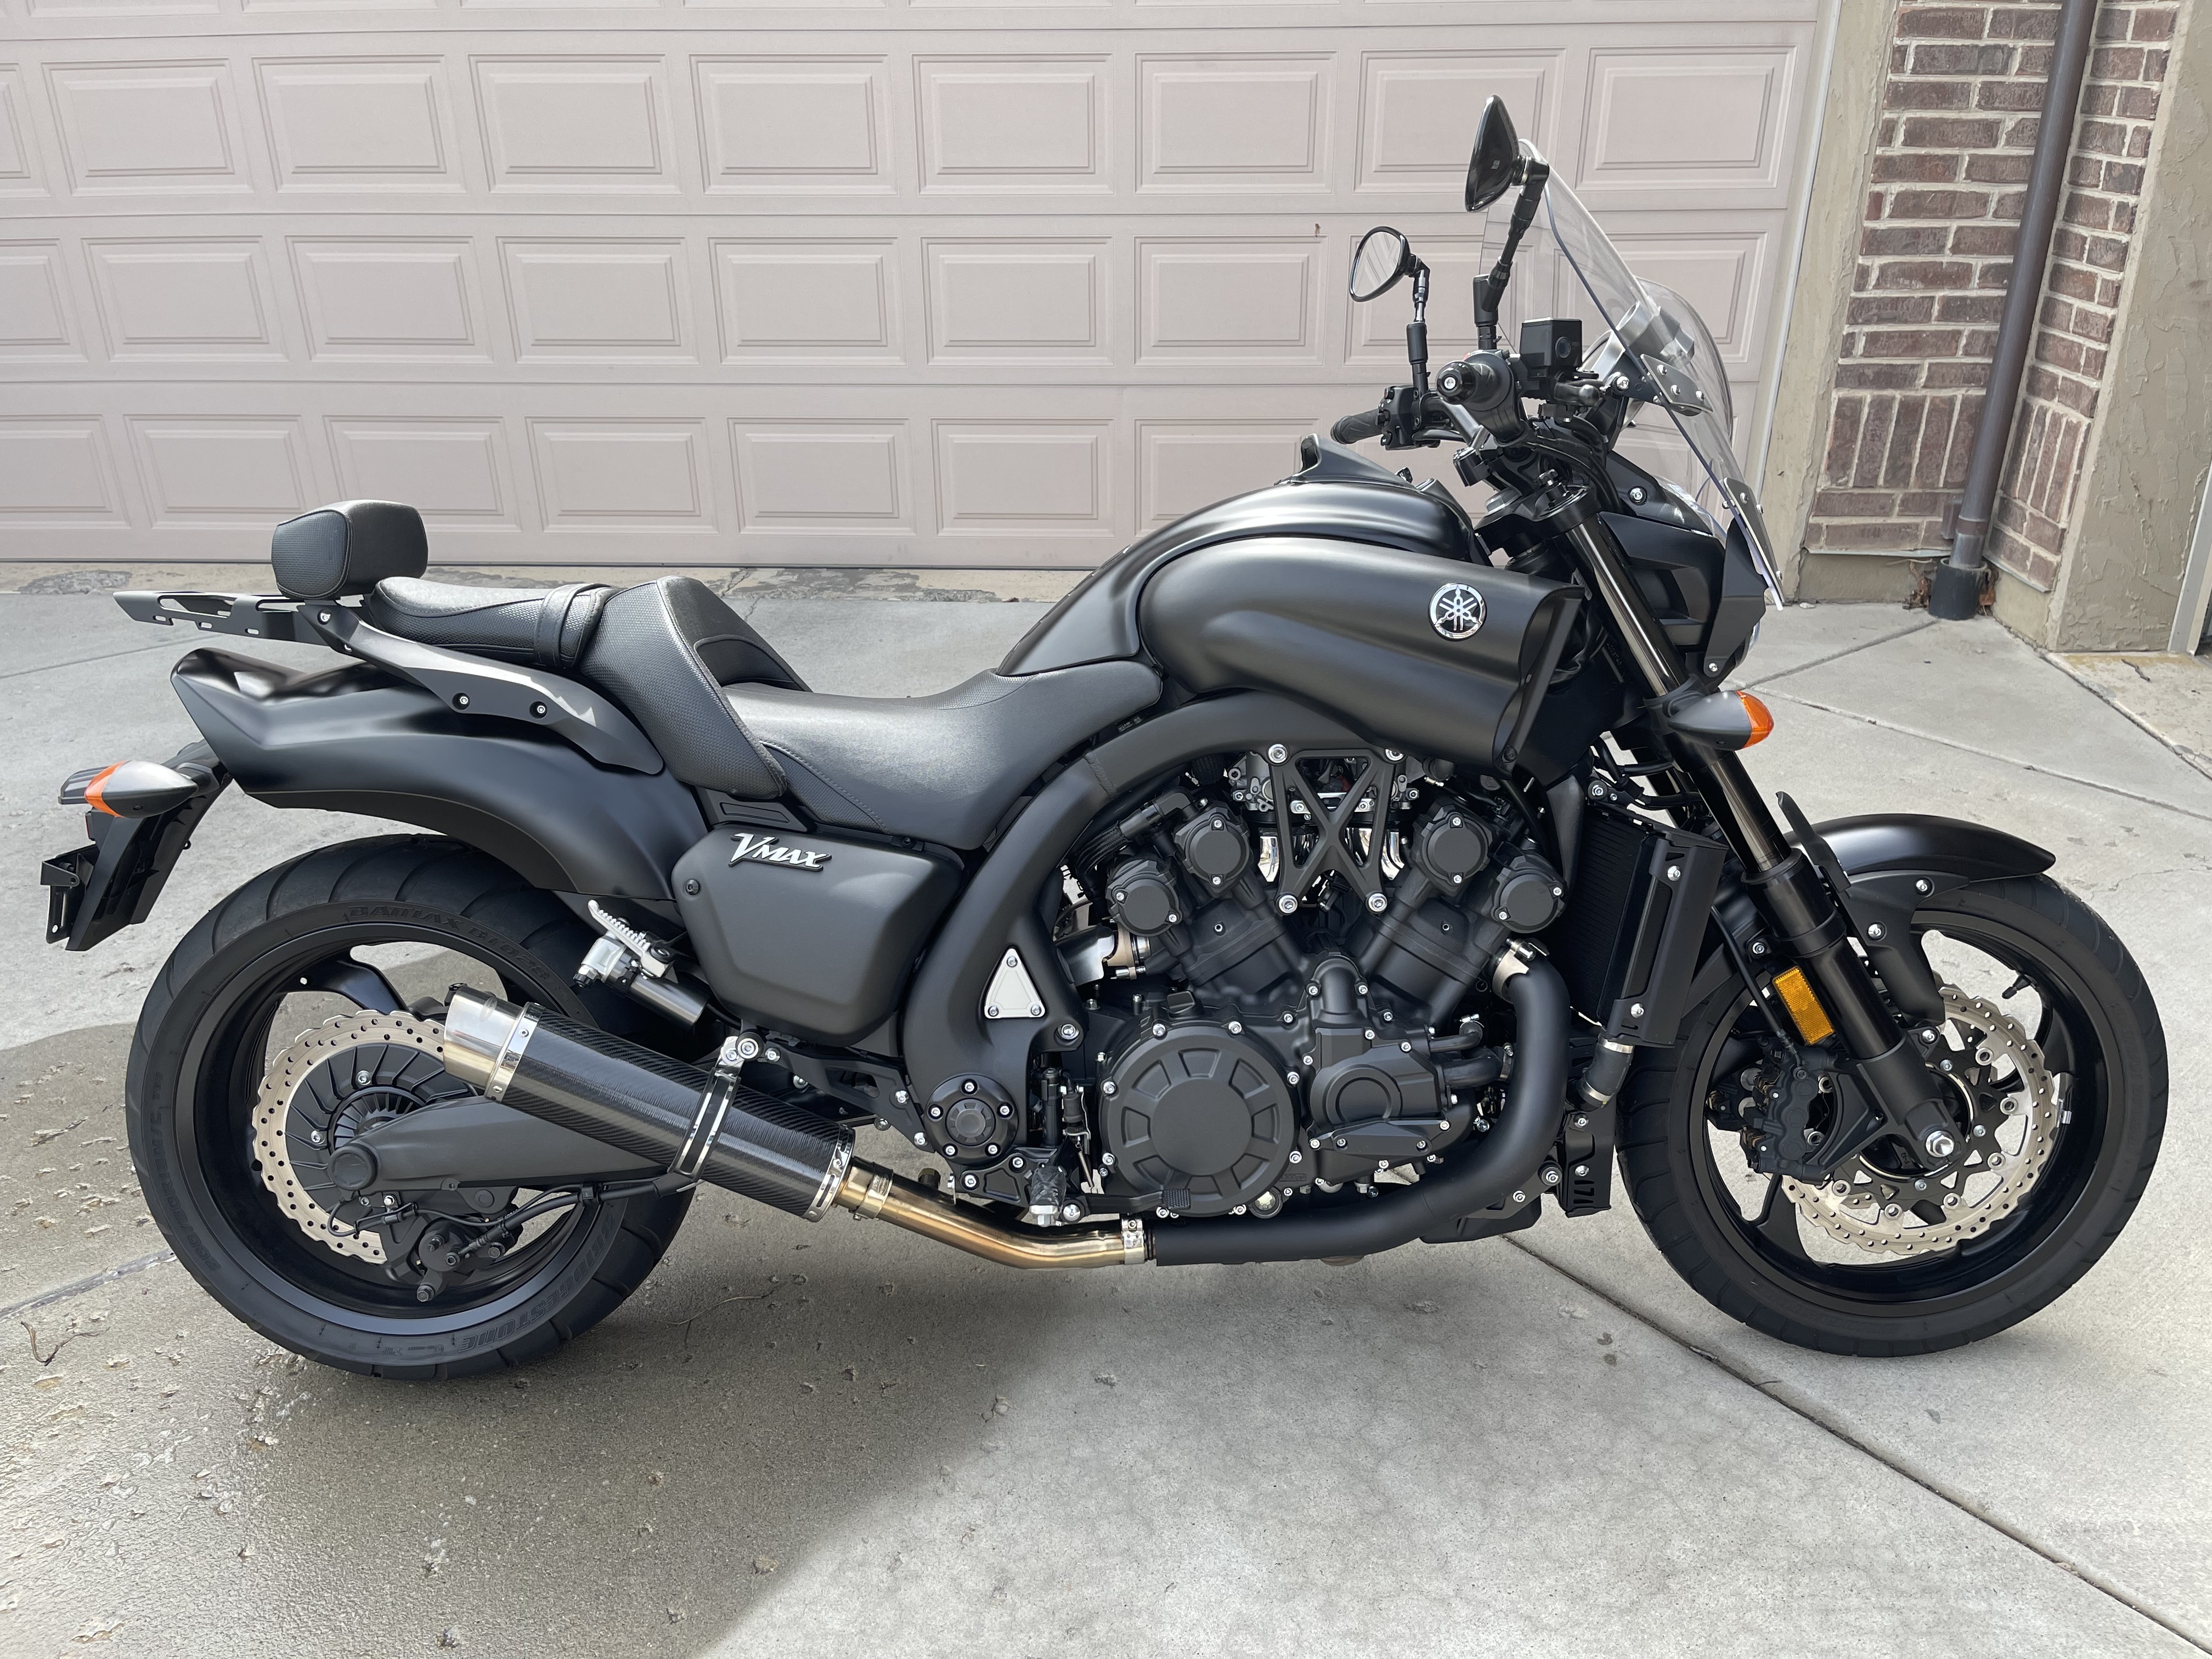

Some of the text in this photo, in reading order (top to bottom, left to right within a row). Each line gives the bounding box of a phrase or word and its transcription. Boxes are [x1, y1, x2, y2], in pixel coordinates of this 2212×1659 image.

[730, 833, 828, 868] VMAX
[348, 905, 462, 931] BATTLAX
[458, 1213, 618, 1352] BRIDGESTONE
